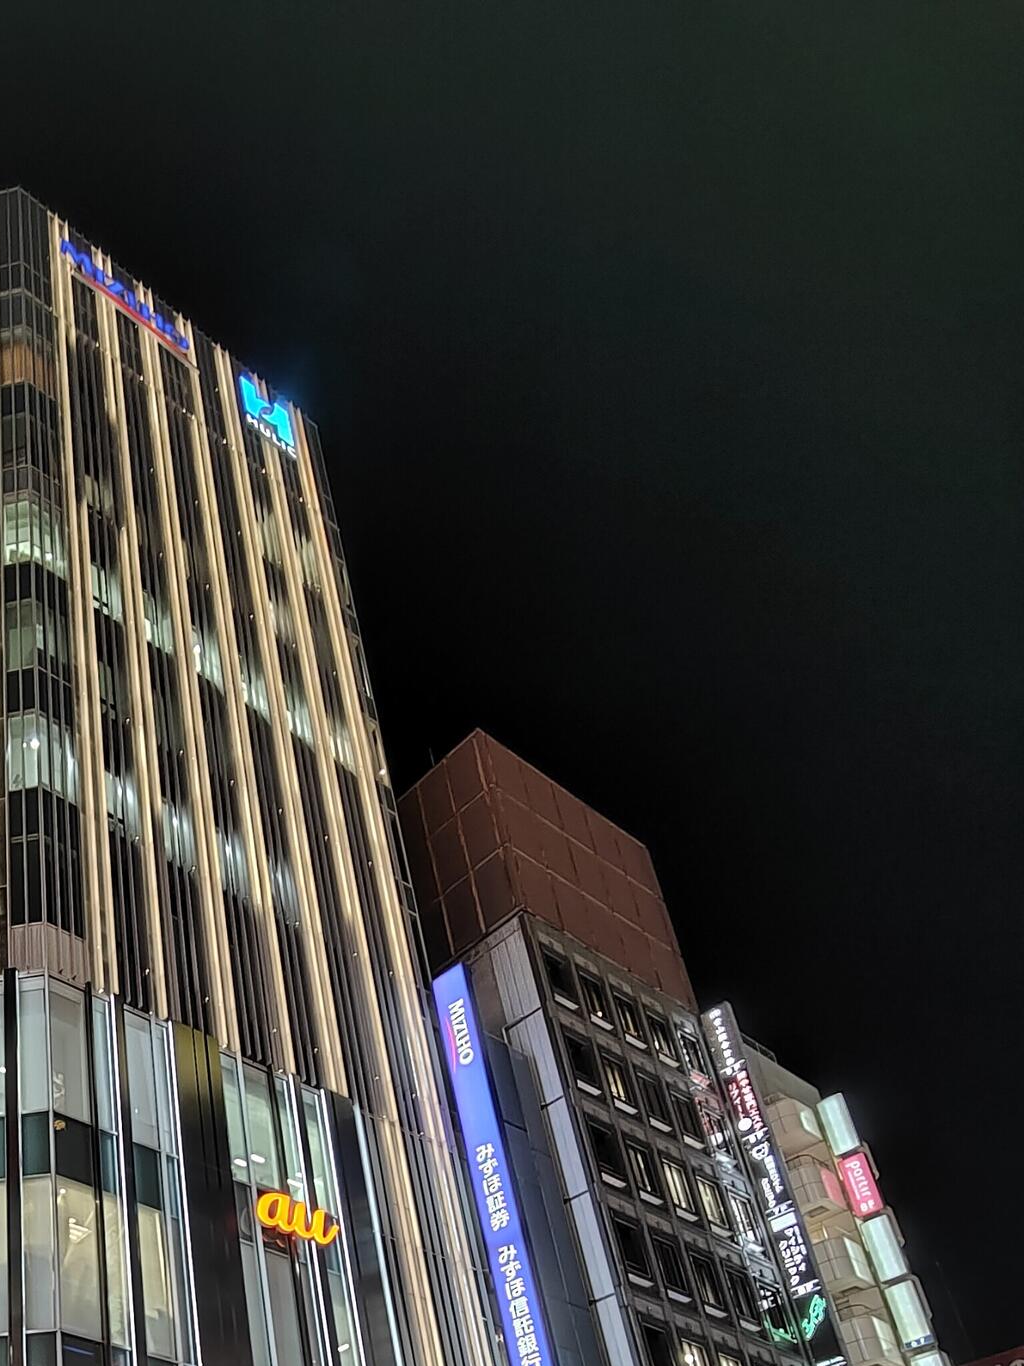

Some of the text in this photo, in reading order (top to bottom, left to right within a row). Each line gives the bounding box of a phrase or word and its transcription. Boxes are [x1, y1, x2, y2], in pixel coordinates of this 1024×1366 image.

[448, 998, 475, 1065] MIZUHO
[256, 1191, 340, 1246] au
[475, 1143, 510, 1232] みずほ証券
